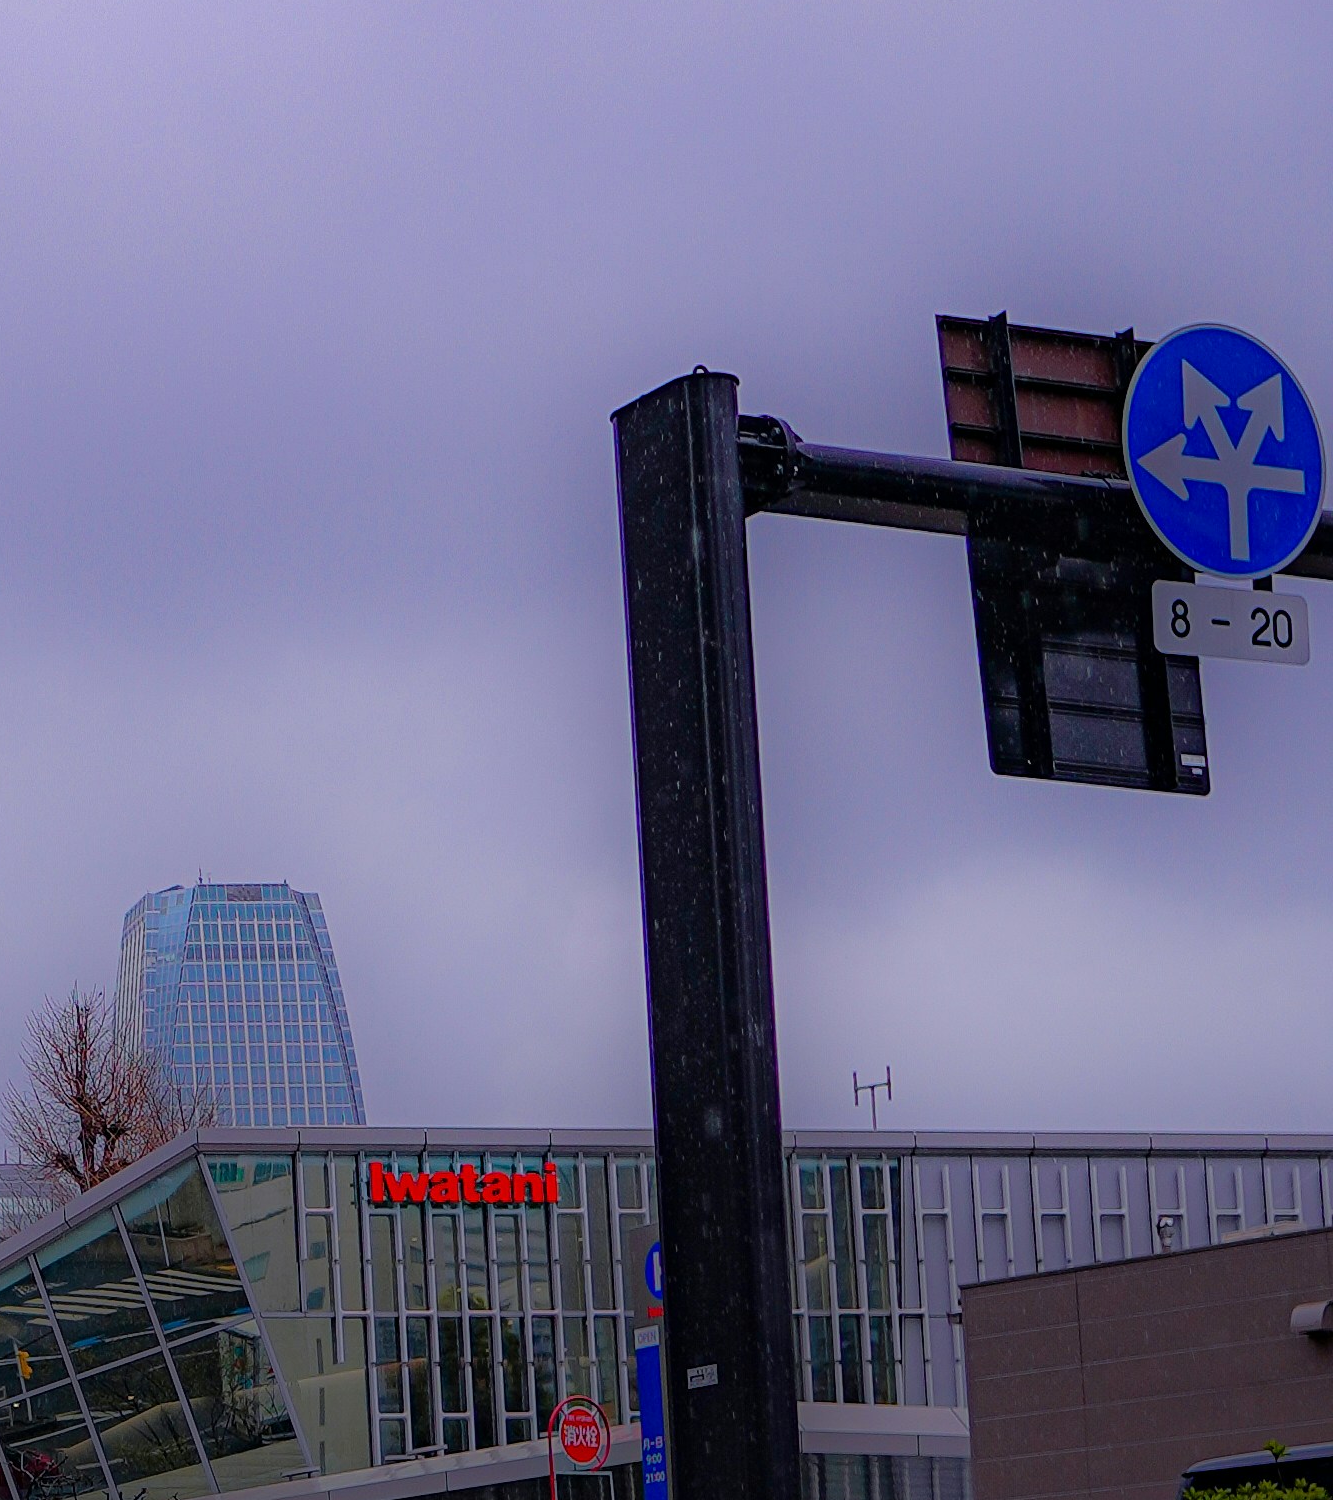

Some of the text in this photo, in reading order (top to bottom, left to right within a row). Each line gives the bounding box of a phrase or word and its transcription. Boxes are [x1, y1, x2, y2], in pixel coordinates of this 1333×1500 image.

[1170, 598, 1192, 639] 8
[1249, 606, 1294, 650] 20
[368, 1161, 560, 1206] Iwatani
[563, 1424, 599, 1449] 消火栓
